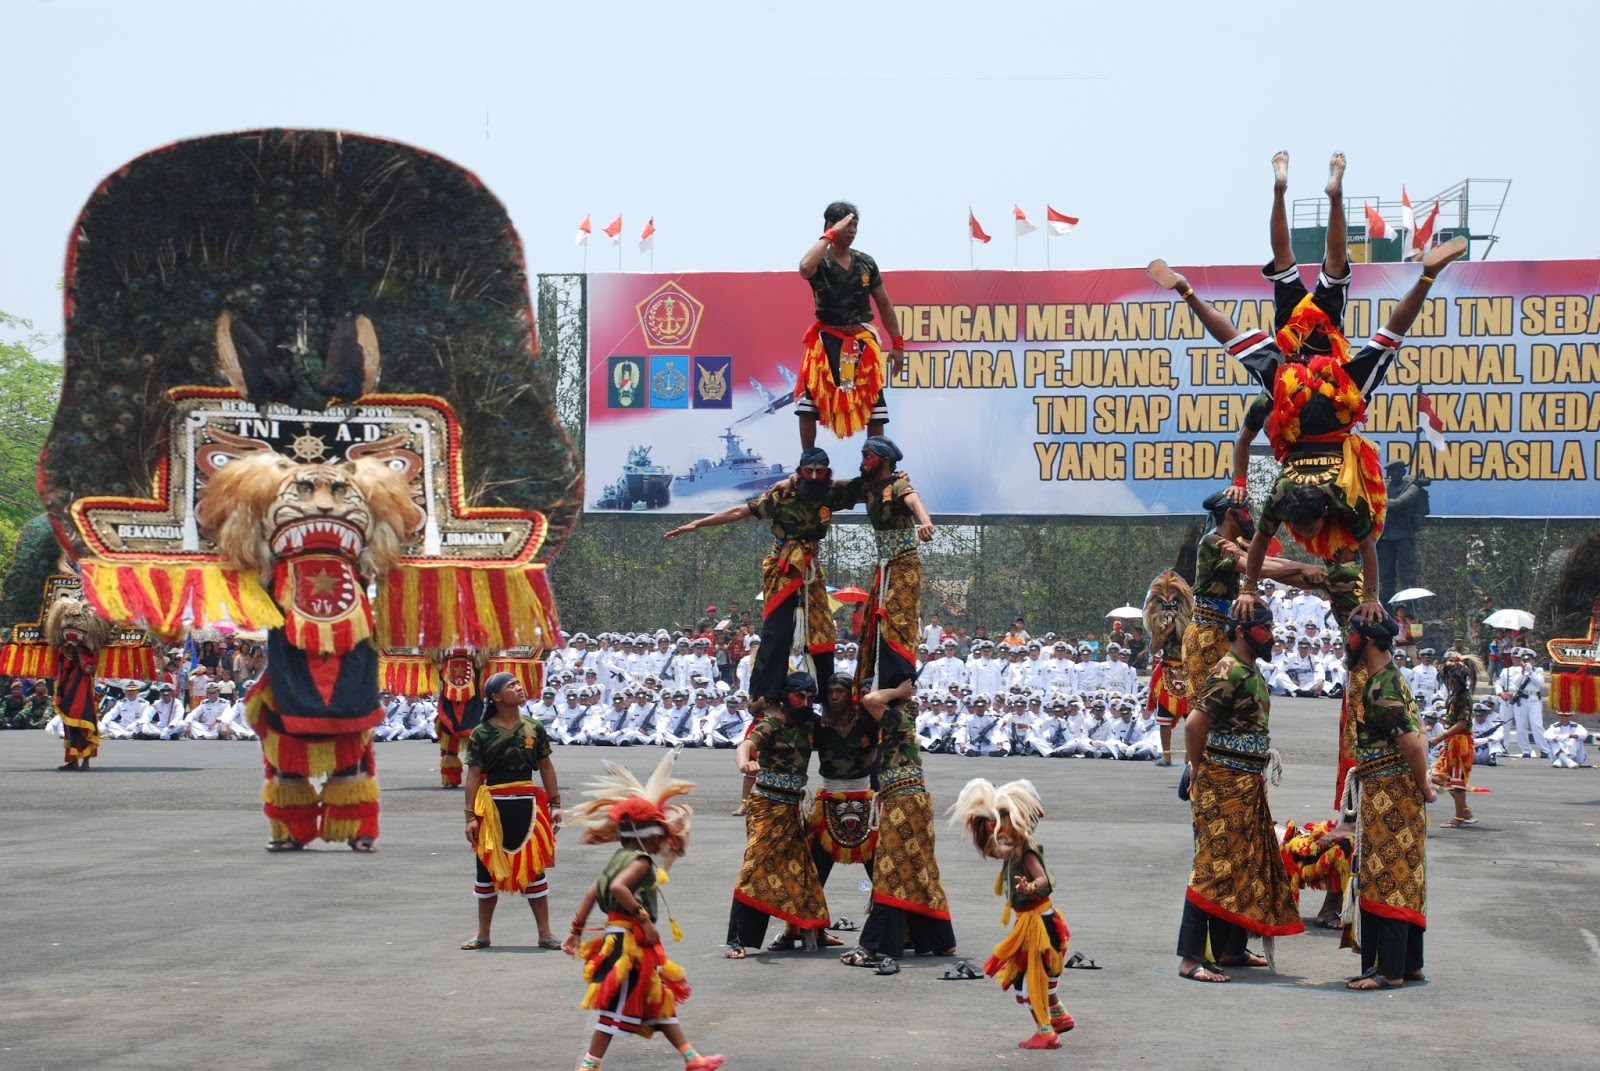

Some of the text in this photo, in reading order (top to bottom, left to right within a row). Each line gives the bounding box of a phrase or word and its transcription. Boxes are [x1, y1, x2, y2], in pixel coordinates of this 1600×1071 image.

[893, 303, 1018, 342] DENGAN
[1377, 297, 1447, 338] DRI
[1455, 296, 1514, 336] TNI
[880, 349, 1018, 389] TENTARA
[1024, 347, 1180, 391] PEJUANG,
[1186, 347, 1260, 386] TEN
[235, 418, 381, 442] TNI A.D
[1033, 395, 1087, 434] TNI
[1093, 395, 1171, 434] SIAP
[1033, 441, 1127, 481] YANG
[1386, 439, 1588, 481] PANCASILA
